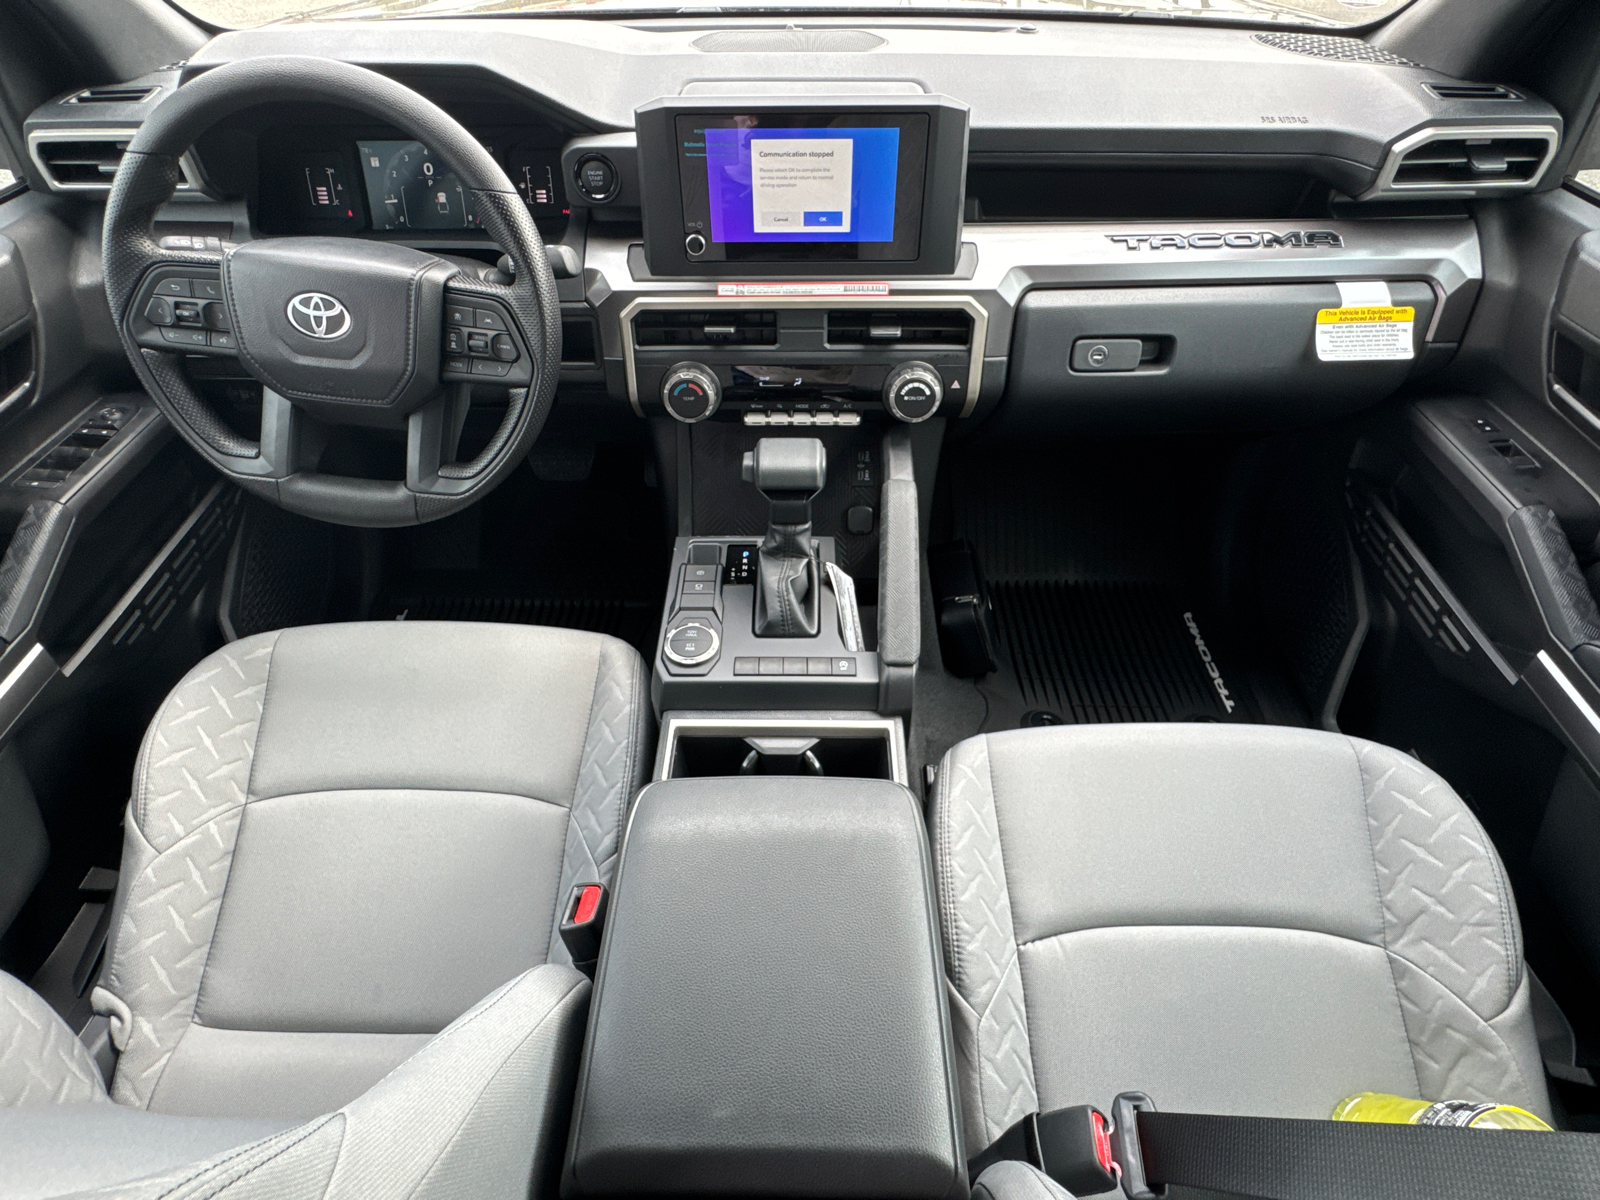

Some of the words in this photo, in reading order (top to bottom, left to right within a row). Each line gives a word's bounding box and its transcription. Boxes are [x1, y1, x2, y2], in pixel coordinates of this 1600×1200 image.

[808, 150, 834, 158] stopped
[423, 162, 434, 175] 0
[1104, 229, 1344, 251] TACOMA
[1367, 308, 1394, 316] Equipped
[1183, 611, 1235, 713] TACOMA
